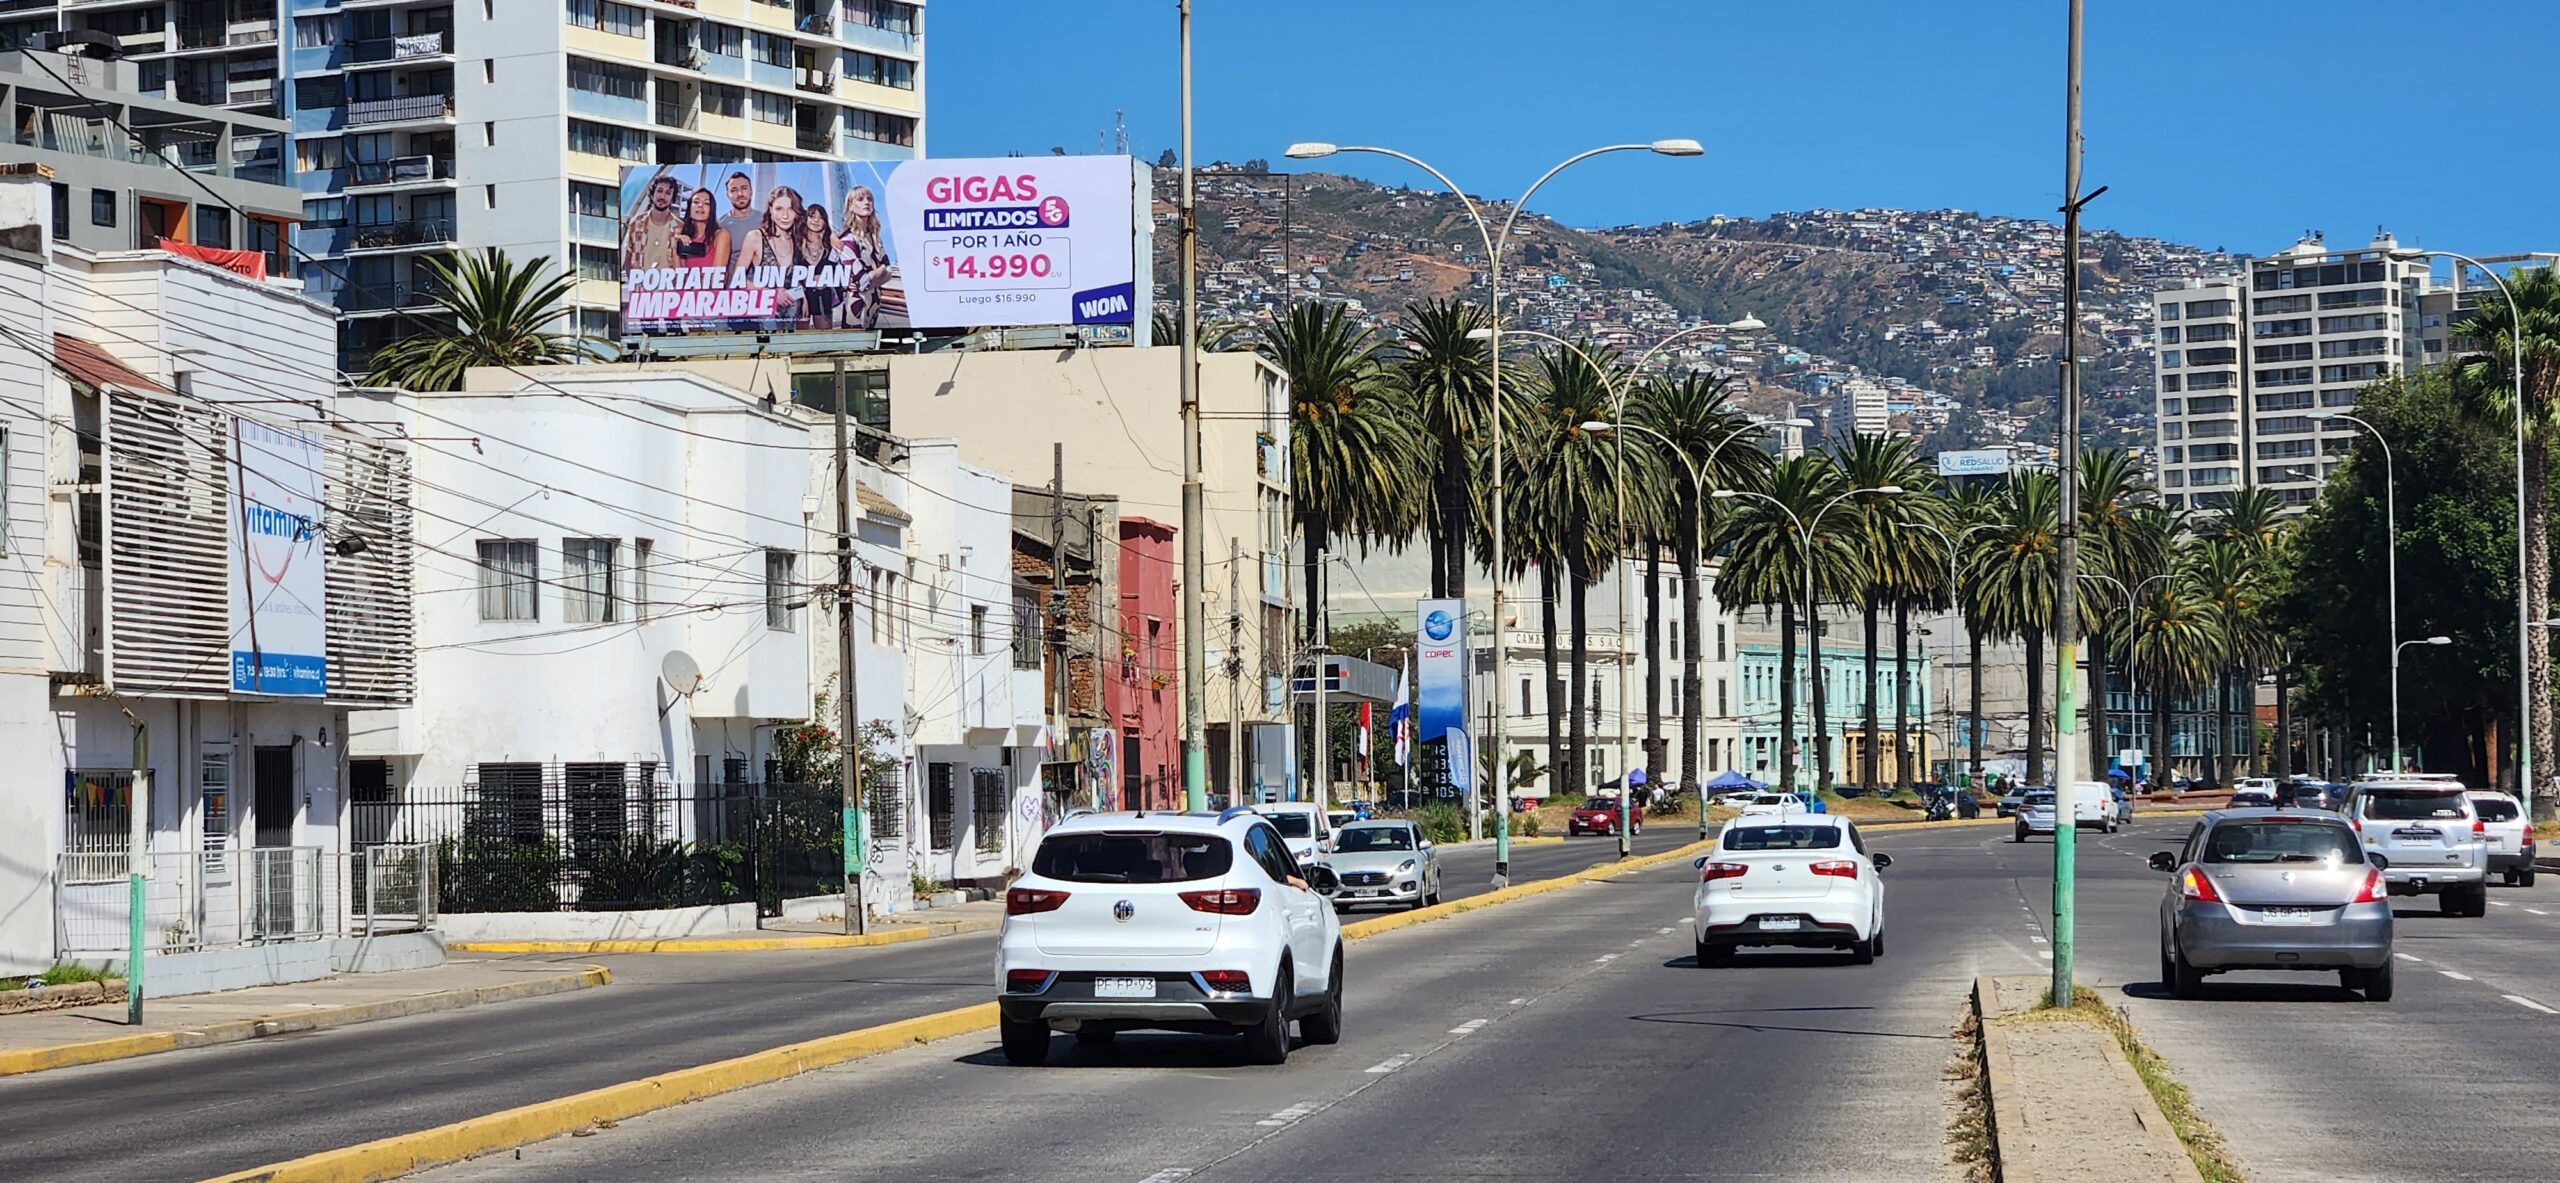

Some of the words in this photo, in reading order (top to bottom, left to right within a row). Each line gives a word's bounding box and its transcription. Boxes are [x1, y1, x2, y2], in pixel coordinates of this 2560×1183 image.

[926, 175, 1038, 203] GIGAS
[928, 210, 1037, 228] ILIMITADOS
[1045, 200, 1063, 221] 5G
[952, 235, 987, 248] POR
[992, 235, 998, 247] 1
[1003, 231, 1042, 247] AÑO
[627, 262, 727, 291] PÓRTATE
[727, 266, 748, 289] A
[754, 265, 786, 288] UN
[791, 264, 852, 288] PLAN
[628, 289, 776, 318] IMPARABLE
[959, 295, 992, 305] Luego
[995, 294, 1036, 303] $16.990
[1079, 294, 1128, 319] WOM
[1960, 458, 2004, 466] REDSALUD
